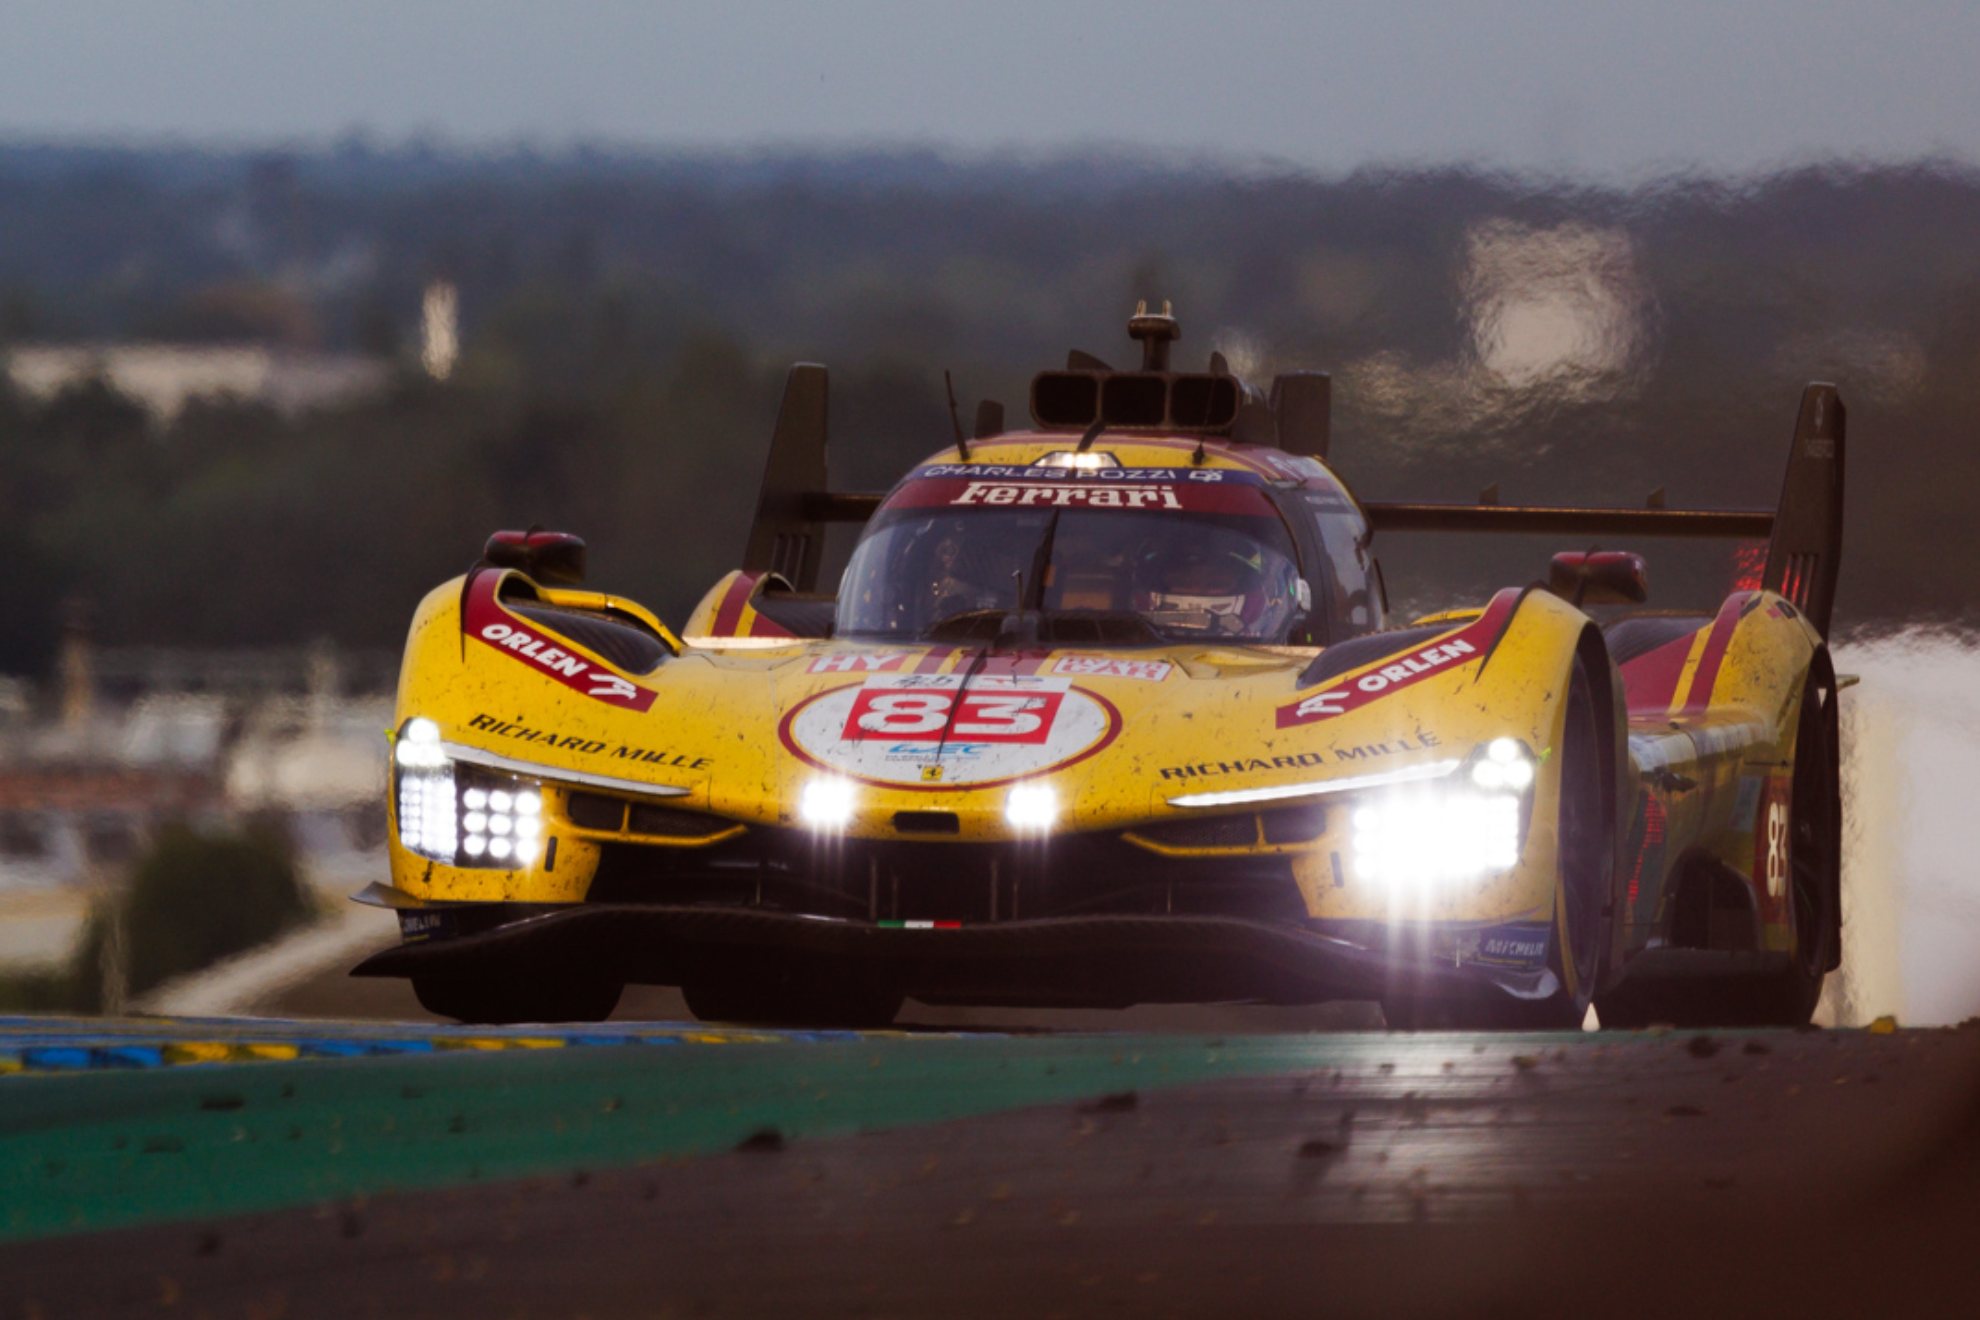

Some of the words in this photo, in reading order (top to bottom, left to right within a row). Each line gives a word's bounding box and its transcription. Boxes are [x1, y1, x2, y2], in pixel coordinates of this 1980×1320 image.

[924, 465, 1068, 479] CHARLES
[1076, 467, 1176, 480] POZZI
[951, 481, 1183, 509] Ferrari
[481, 624, 588, 678] ORLEN
[812, 656, 892, 672] HY
[1358, 639, 1476, 692] ORLEN
[857, 693, 1046, 735] 83
[467, 713, 606, 755] RICHARD
[610, 745, 715, 771] MILLE
[1159, 752, 1322, 781] RICHARD
[1335, 731, 1442, 762] MILLE
